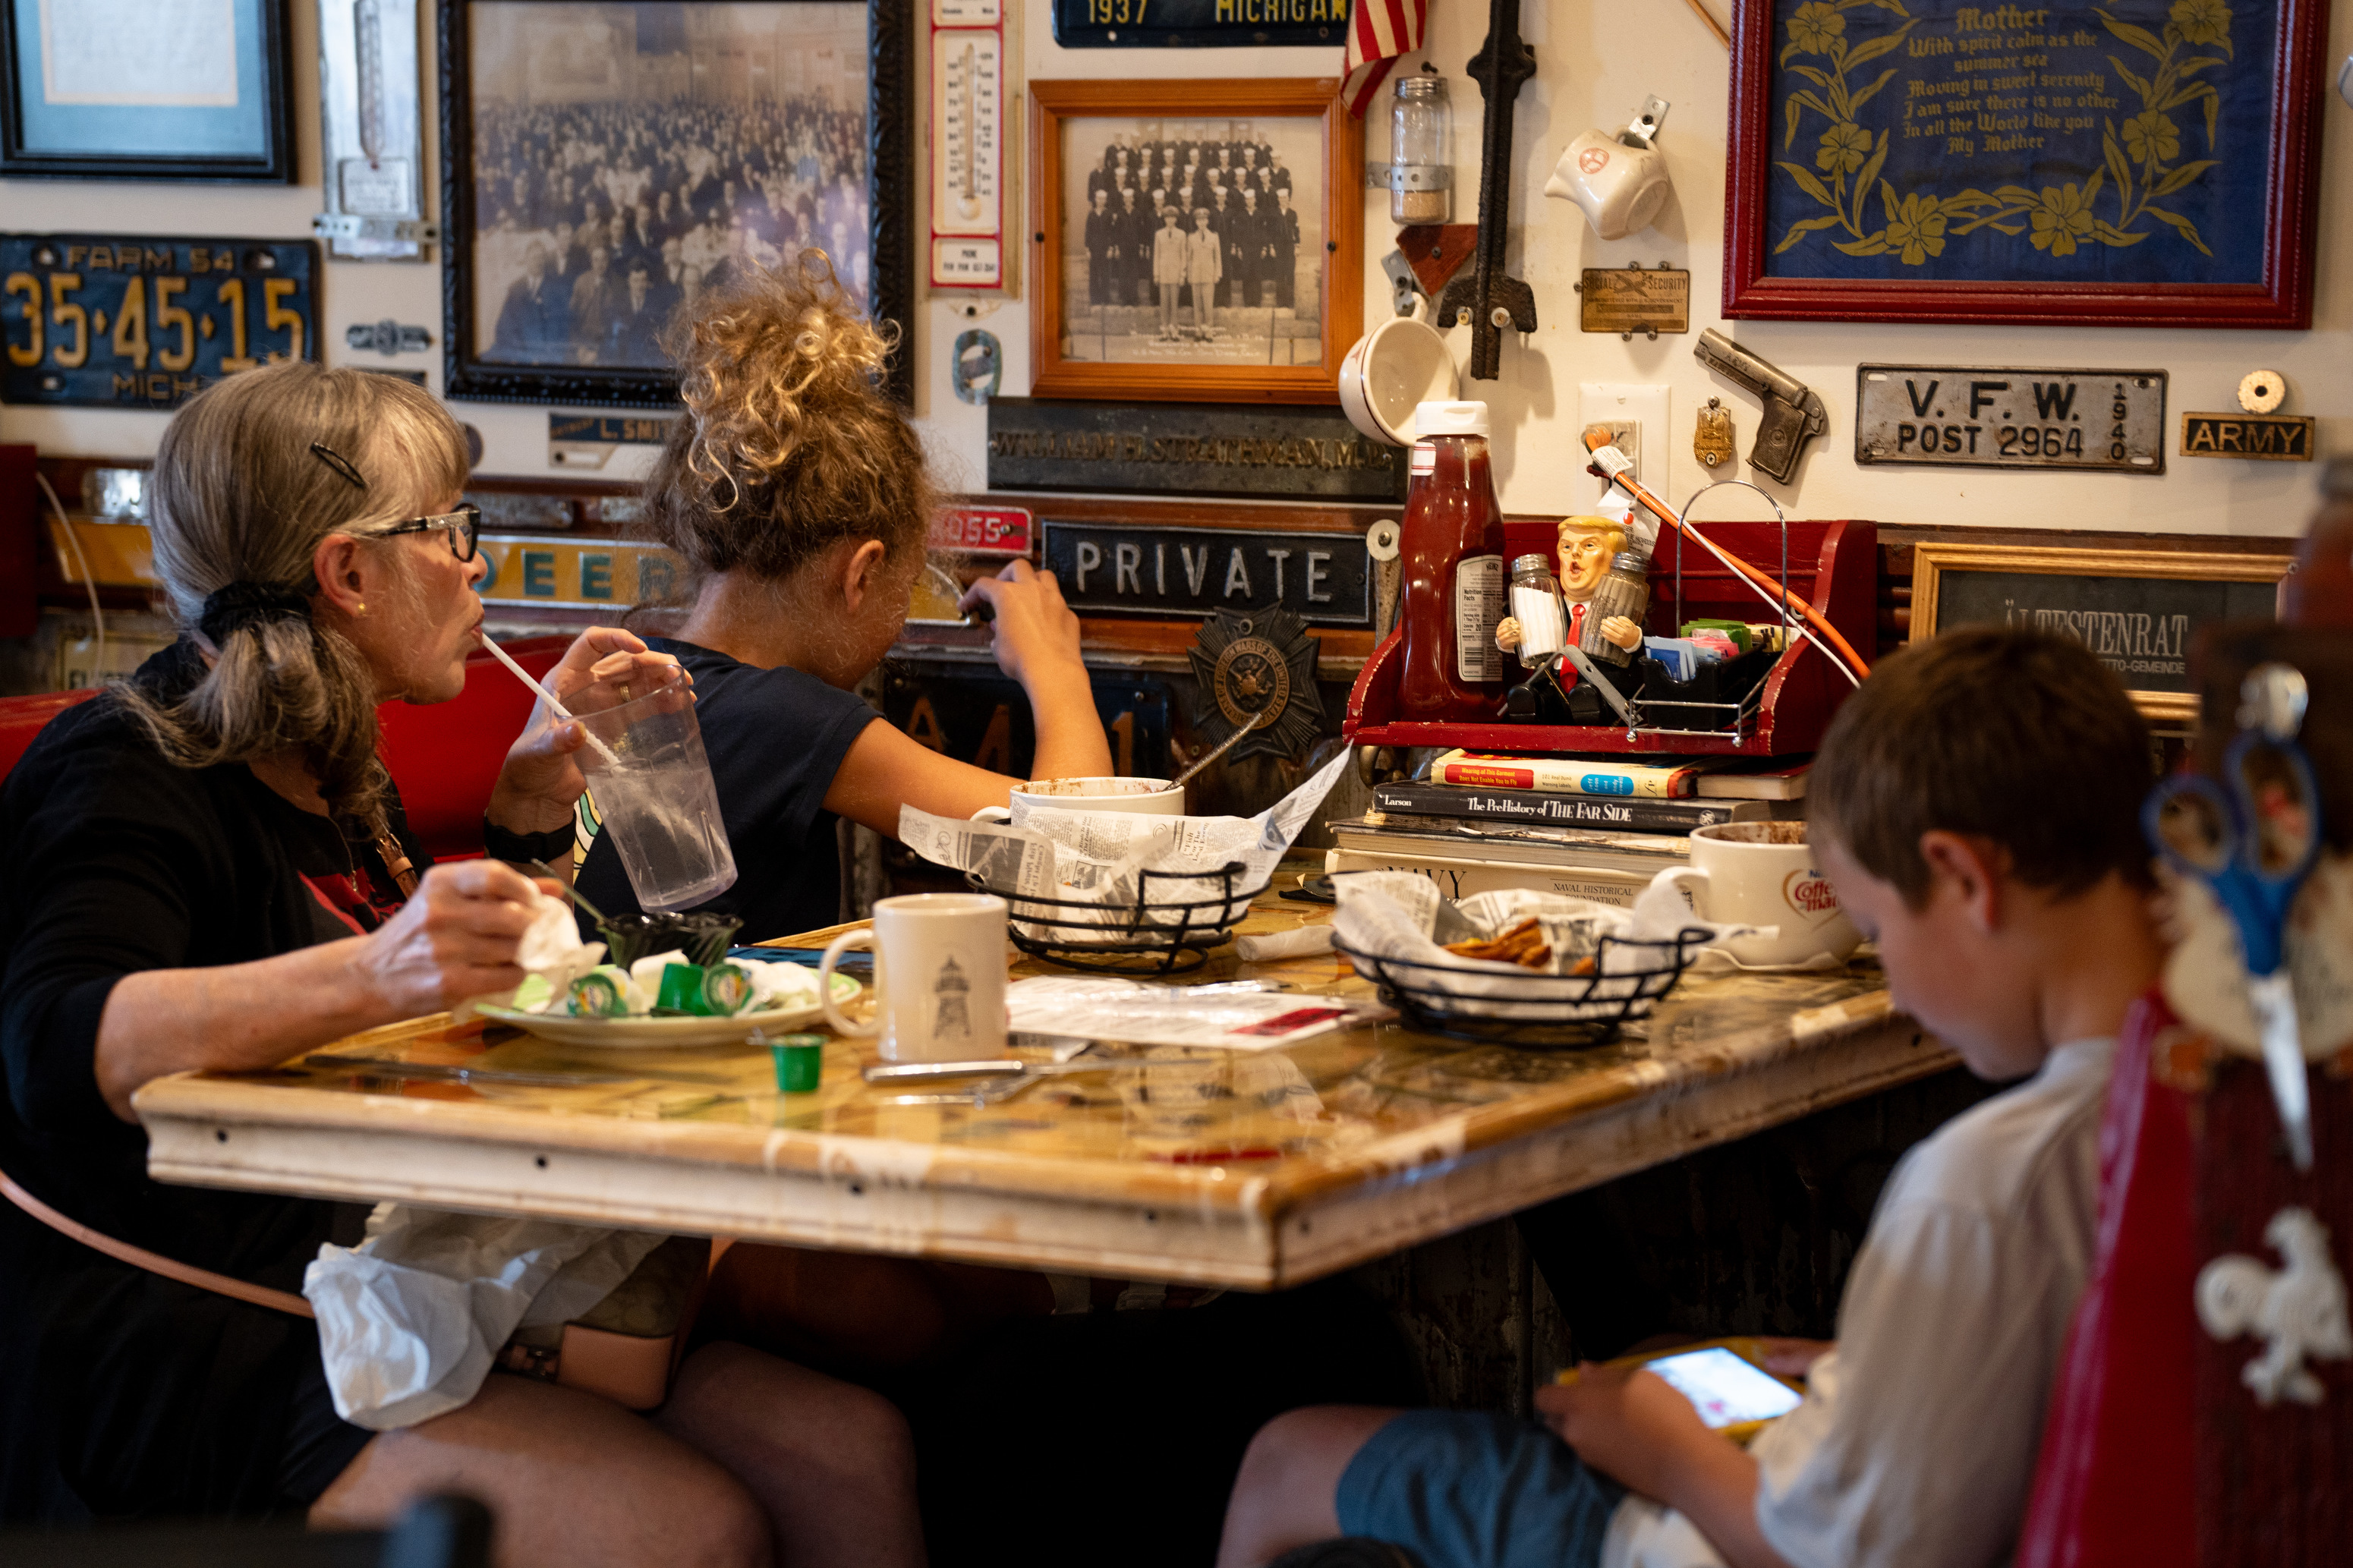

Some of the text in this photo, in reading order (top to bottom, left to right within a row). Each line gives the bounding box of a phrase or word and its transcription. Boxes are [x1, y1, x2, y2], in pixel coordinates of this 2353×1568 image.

[1088, 0, 1347, 24] 1937 MICHIGAN
[1955, 4, 2049, 34] Mother
[1908, 29, 2097, 58] With spirit calm as the
[1955, 54, 2048, 73] summer sea
[1907, 70, 2105, 99] Moving in sweet serenity
[1904, 92, 2119, 119] I am sure there is no other
[1902, 112, 2094, 138] In all the World like you
[1947, 132, 2045, 158] My Mother
[67, 245, 235, 272] FARM 54
[1584, 276, 1687, 290] SOCIAL SECURITY
[112, 373, 199, 400] MICH
[1905, 379, 2080, 422] V. F. W.
[2110, 383, 2127, 461] 1940
[995, 431, 1116, 460] WILLIAM
[1898, 424, 2083, 457] POST 2964
[2191, 423, 2304, 454] ARMY
[1076, 541, 1333, 603] PRIVATE
[1485, 562, 1498, 571] HEINZ
[1234, 640, 1256, 653] WARS
[1256, 641, 1268, 653] OF
[1267, 647, 1280, 665] THE
[1277, 663, 1288, 696] UNITED
[2099, 658, 2185, 675] TTO-GEMEINDE
[1384, 794, 1412, 807] Larson
[1468, 797, 1485, 811] The
[1487, 798, 1536, 816] PreHistory
[1537, 801, 1548, 816] of
[1550, 801, 1574, 819] THE
[1577, 802, 1600, 820] FAR
[1602, 804, 1633, 822] SIDE
[1554, 883, 1633, 896] NAVAL HISTORICAL
[1565, 894, 1621, 905] NDATION
